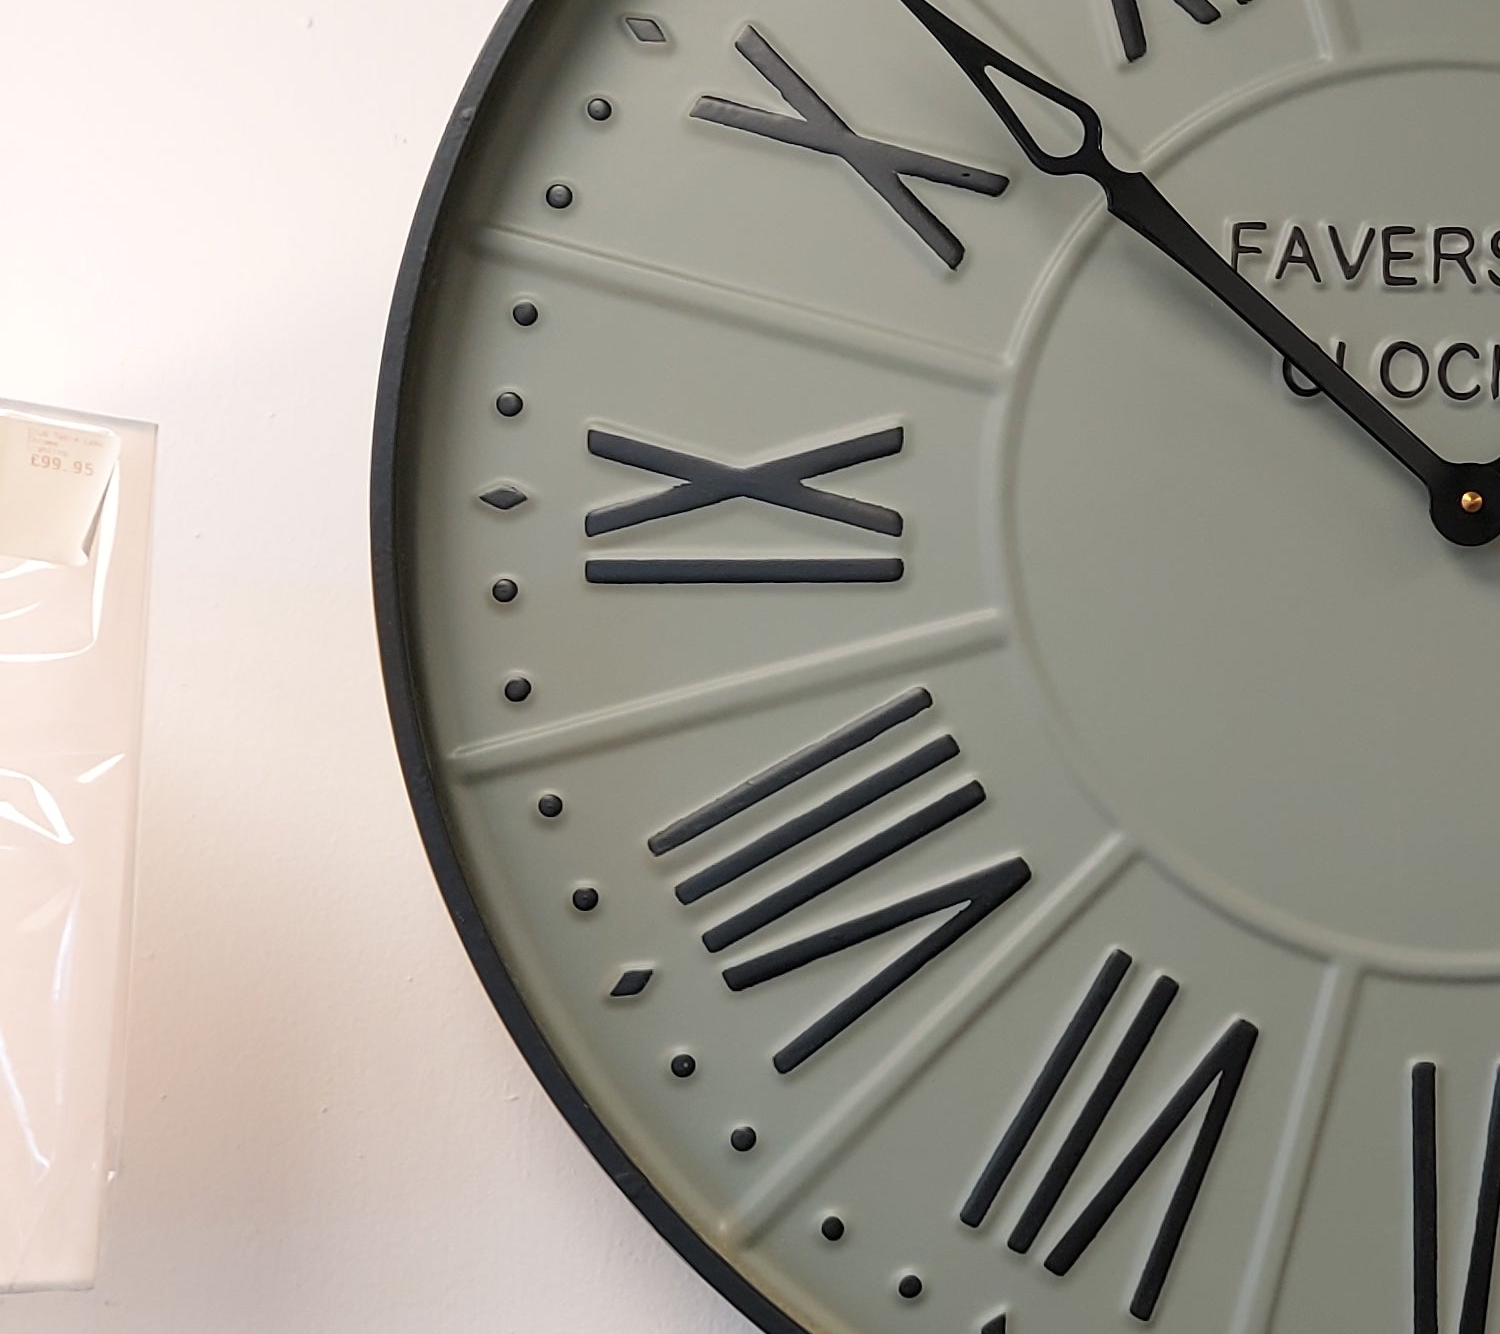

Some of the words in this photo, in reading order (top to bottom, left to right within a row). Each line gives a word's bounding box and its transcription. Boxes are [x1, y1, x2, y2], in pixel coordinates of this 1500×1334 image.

[689, 23, 1010, 270] X
[31, 453, 94, 476] £99.95
[585, 425, 904, 584] IX
[648, 686, 1032, 1074] VIII
[960, 948, 1260, 1322] VII
